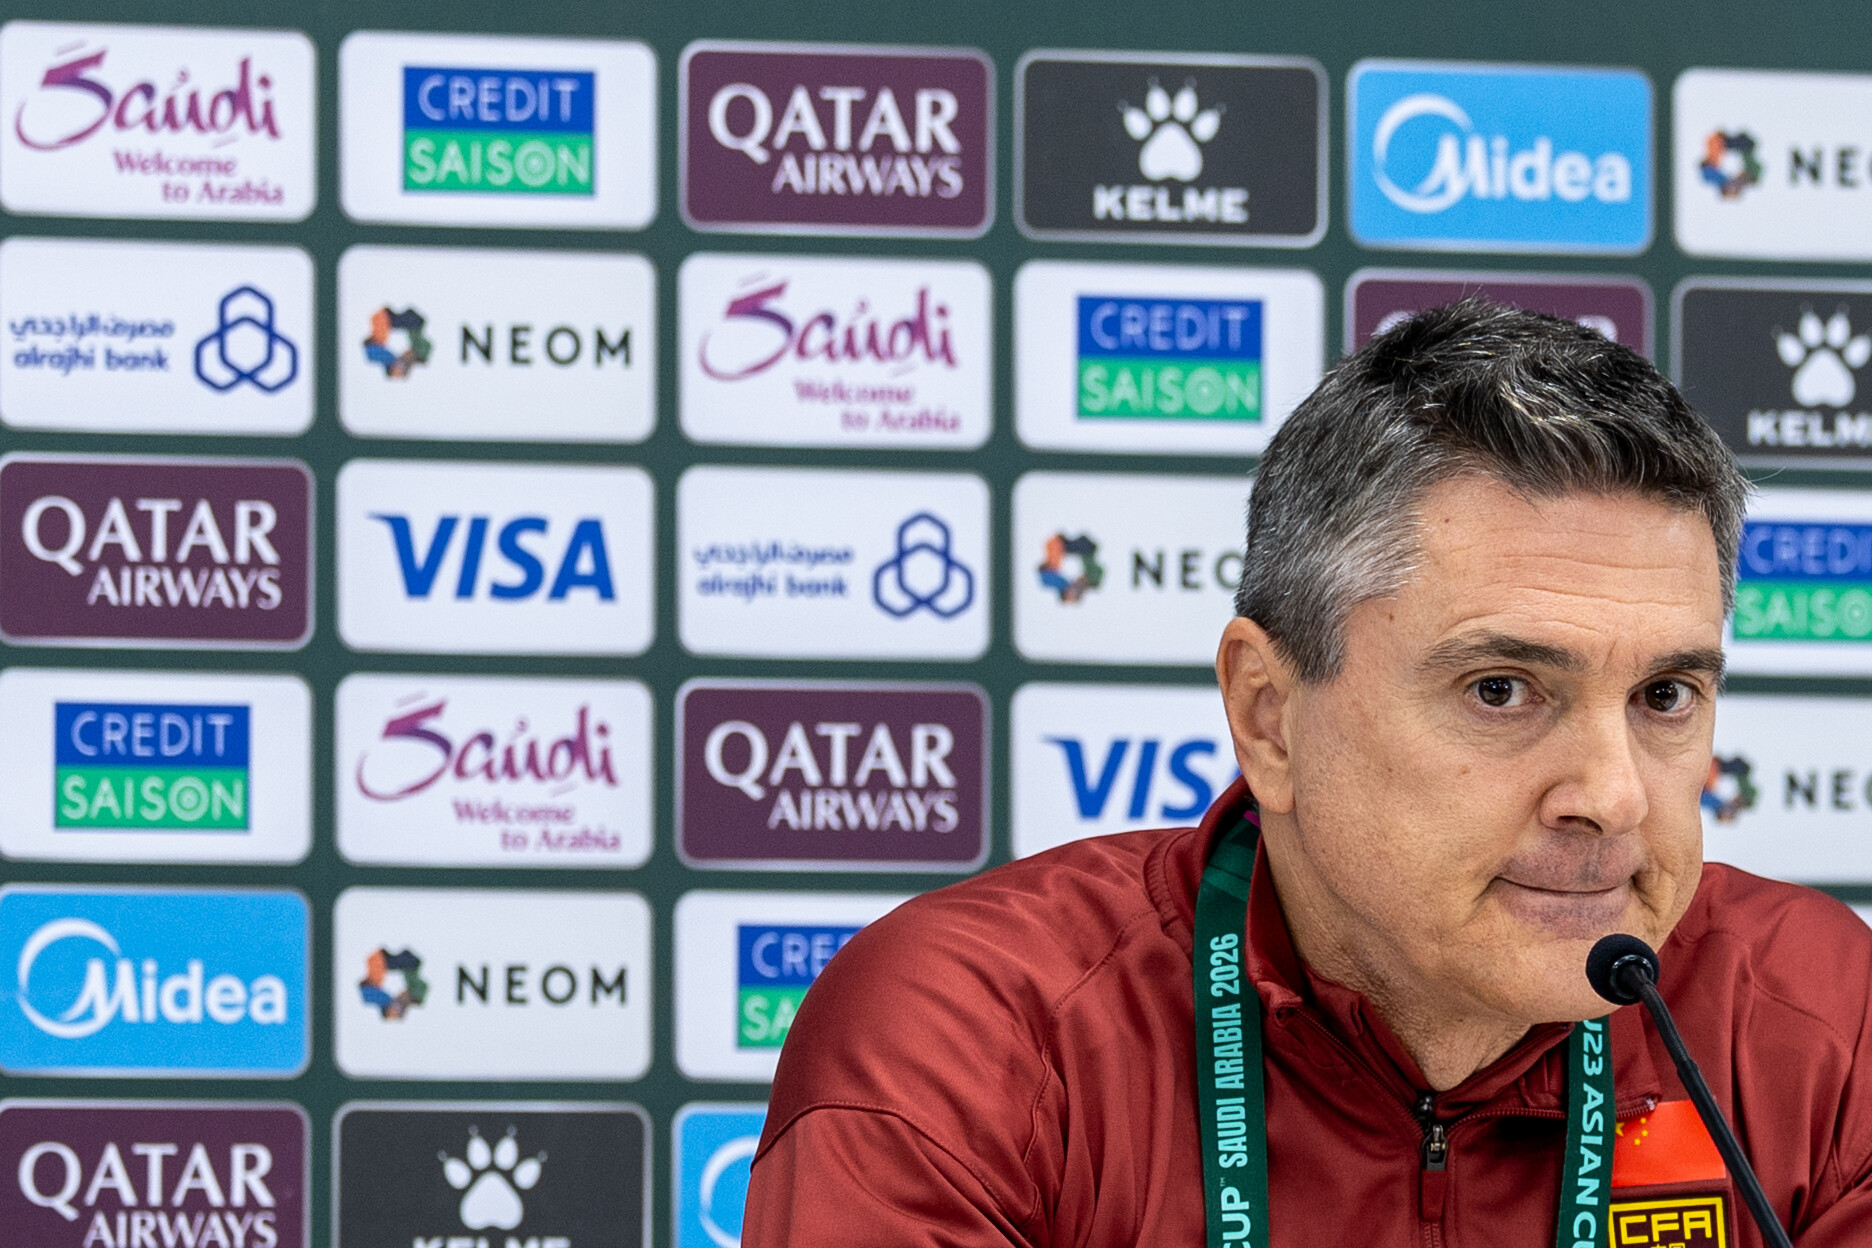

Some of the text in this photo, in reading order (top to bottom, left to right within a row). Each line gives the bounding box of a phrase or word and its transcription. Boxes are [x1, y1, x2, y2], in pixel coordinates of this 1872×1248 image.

[418, 73, 579, 123] CREDIT
[707, 83, 960, 168] QATAR
[112, 148, 236, 176] Welcome
[409, 138, 590, 187] SAISON
[772, 152, 961, 199] AIRWAYS
[161, 179, 283, 205] to Arabia
[1092, 185, 1248, 223] KELME
[459, 324, 632, 368] NEOM
[1091, 303, 1248, 352] CREDIT
[12, 347, 171, 377] alrajhi bank
[793, 379, 914, 405] Welcome
[1082, 367, 1258, 415] SAISON
[841, 409, 960, 434] to Arabia
[20, 495, 280, 579] QATAR
[369, 512, 617, 602] VISA
[86, 564, 281, 611] AIRWAYS
[696, 575, 850, 605] alrajhi bank
[1132, 550, 1247, 590] NEO
[70, 709, 233, 758] CREDIT
[703, 721, 956, 803] QATAR
[1042, 737, 1242, 821] VIS
[62, 775, 245, 823] SAISON
[452, 799, 574, 824] Welcome
[768, 789, 957, 834] AIRWAYS
[500, 829, 621, 853] to Arabia
[751, 930, 857, 980] CRE
[1210, 933, 1240, 997] 2026
[455, 965, 629, 1006] NEOM
[1211, 1003, 1245, 1089] ARABIA
[1215, 1097, 1248, 1169] SAUDI
[1575, 1082, 1604, 1206] ASIAN
[17, 1141, 276, 1222] QATAR
[1619, 1210, 1713, 1245] CFA
